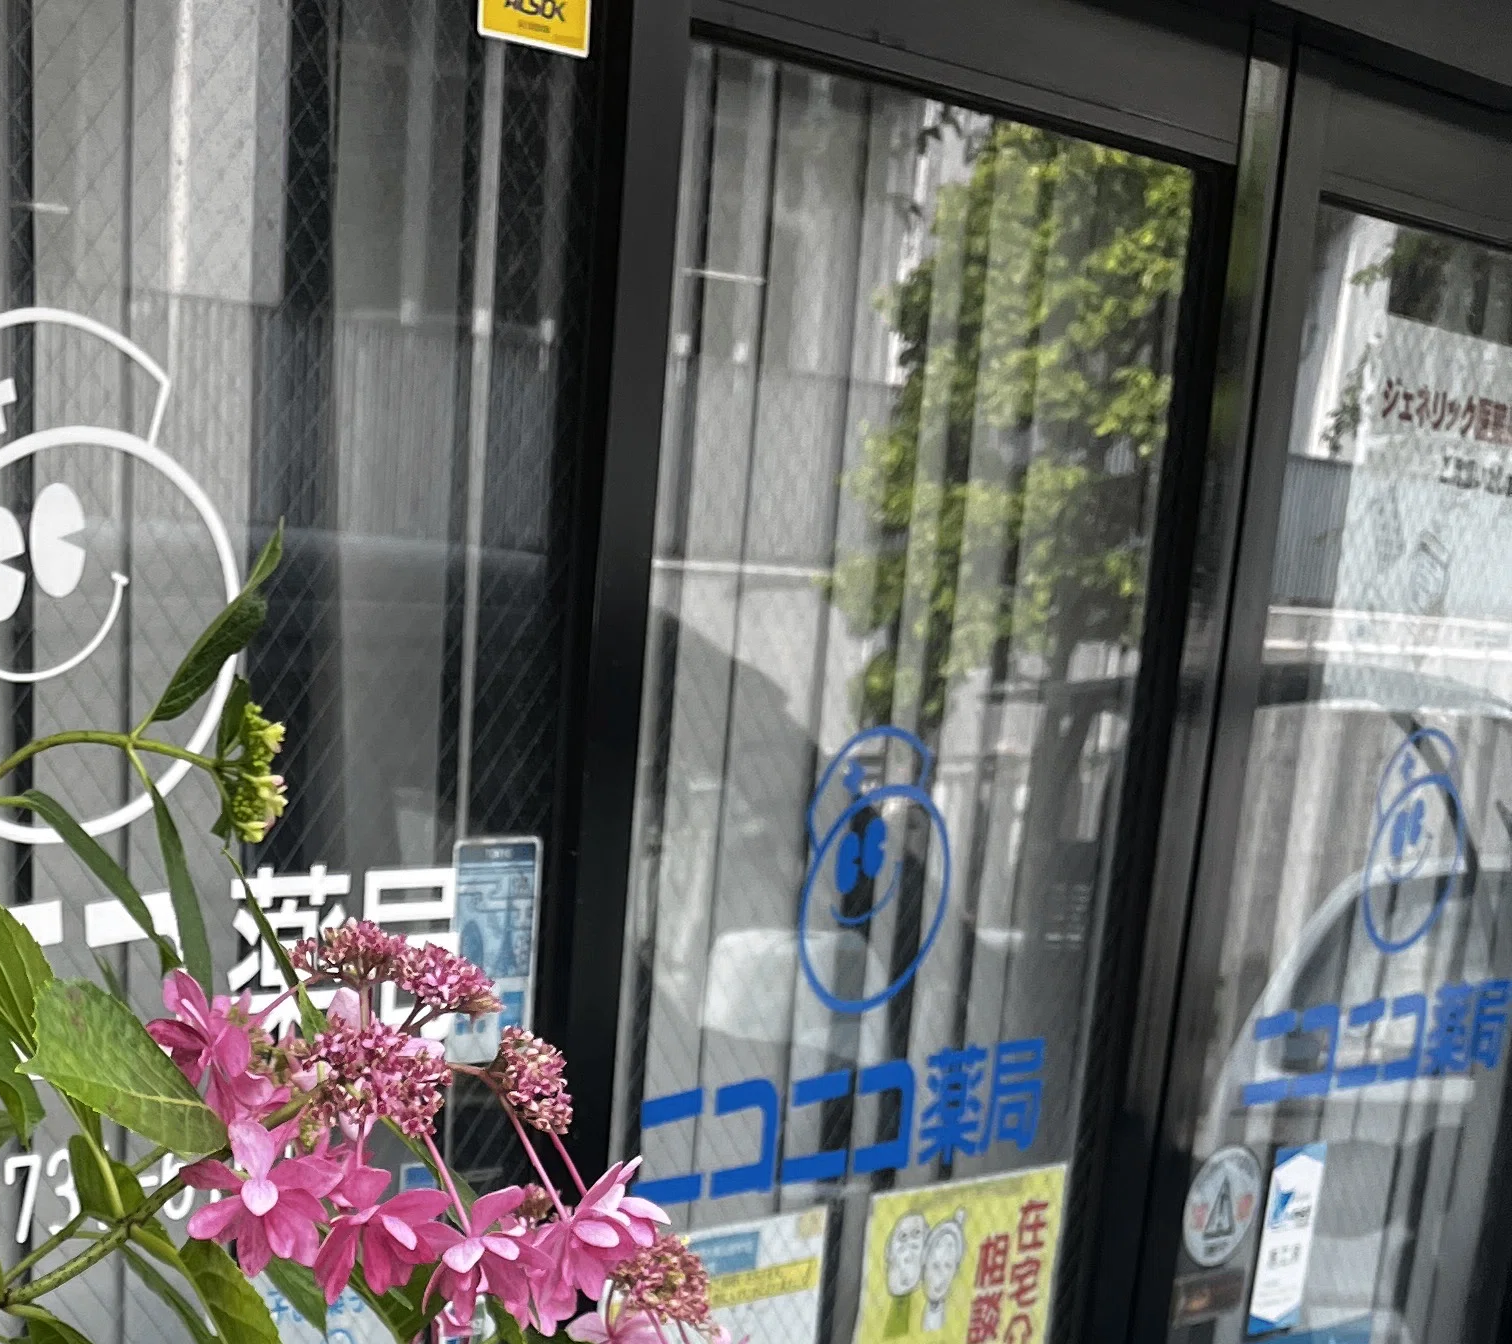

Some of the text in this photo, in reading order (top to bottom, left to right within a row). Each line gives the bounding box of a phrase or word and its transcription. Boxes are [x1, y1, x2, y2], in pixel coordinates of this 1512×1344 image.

[1242, 979, 1512, 1106] ニコニコ薬局
[631, 1036, 1046, 1205] ニコニコ薬局
